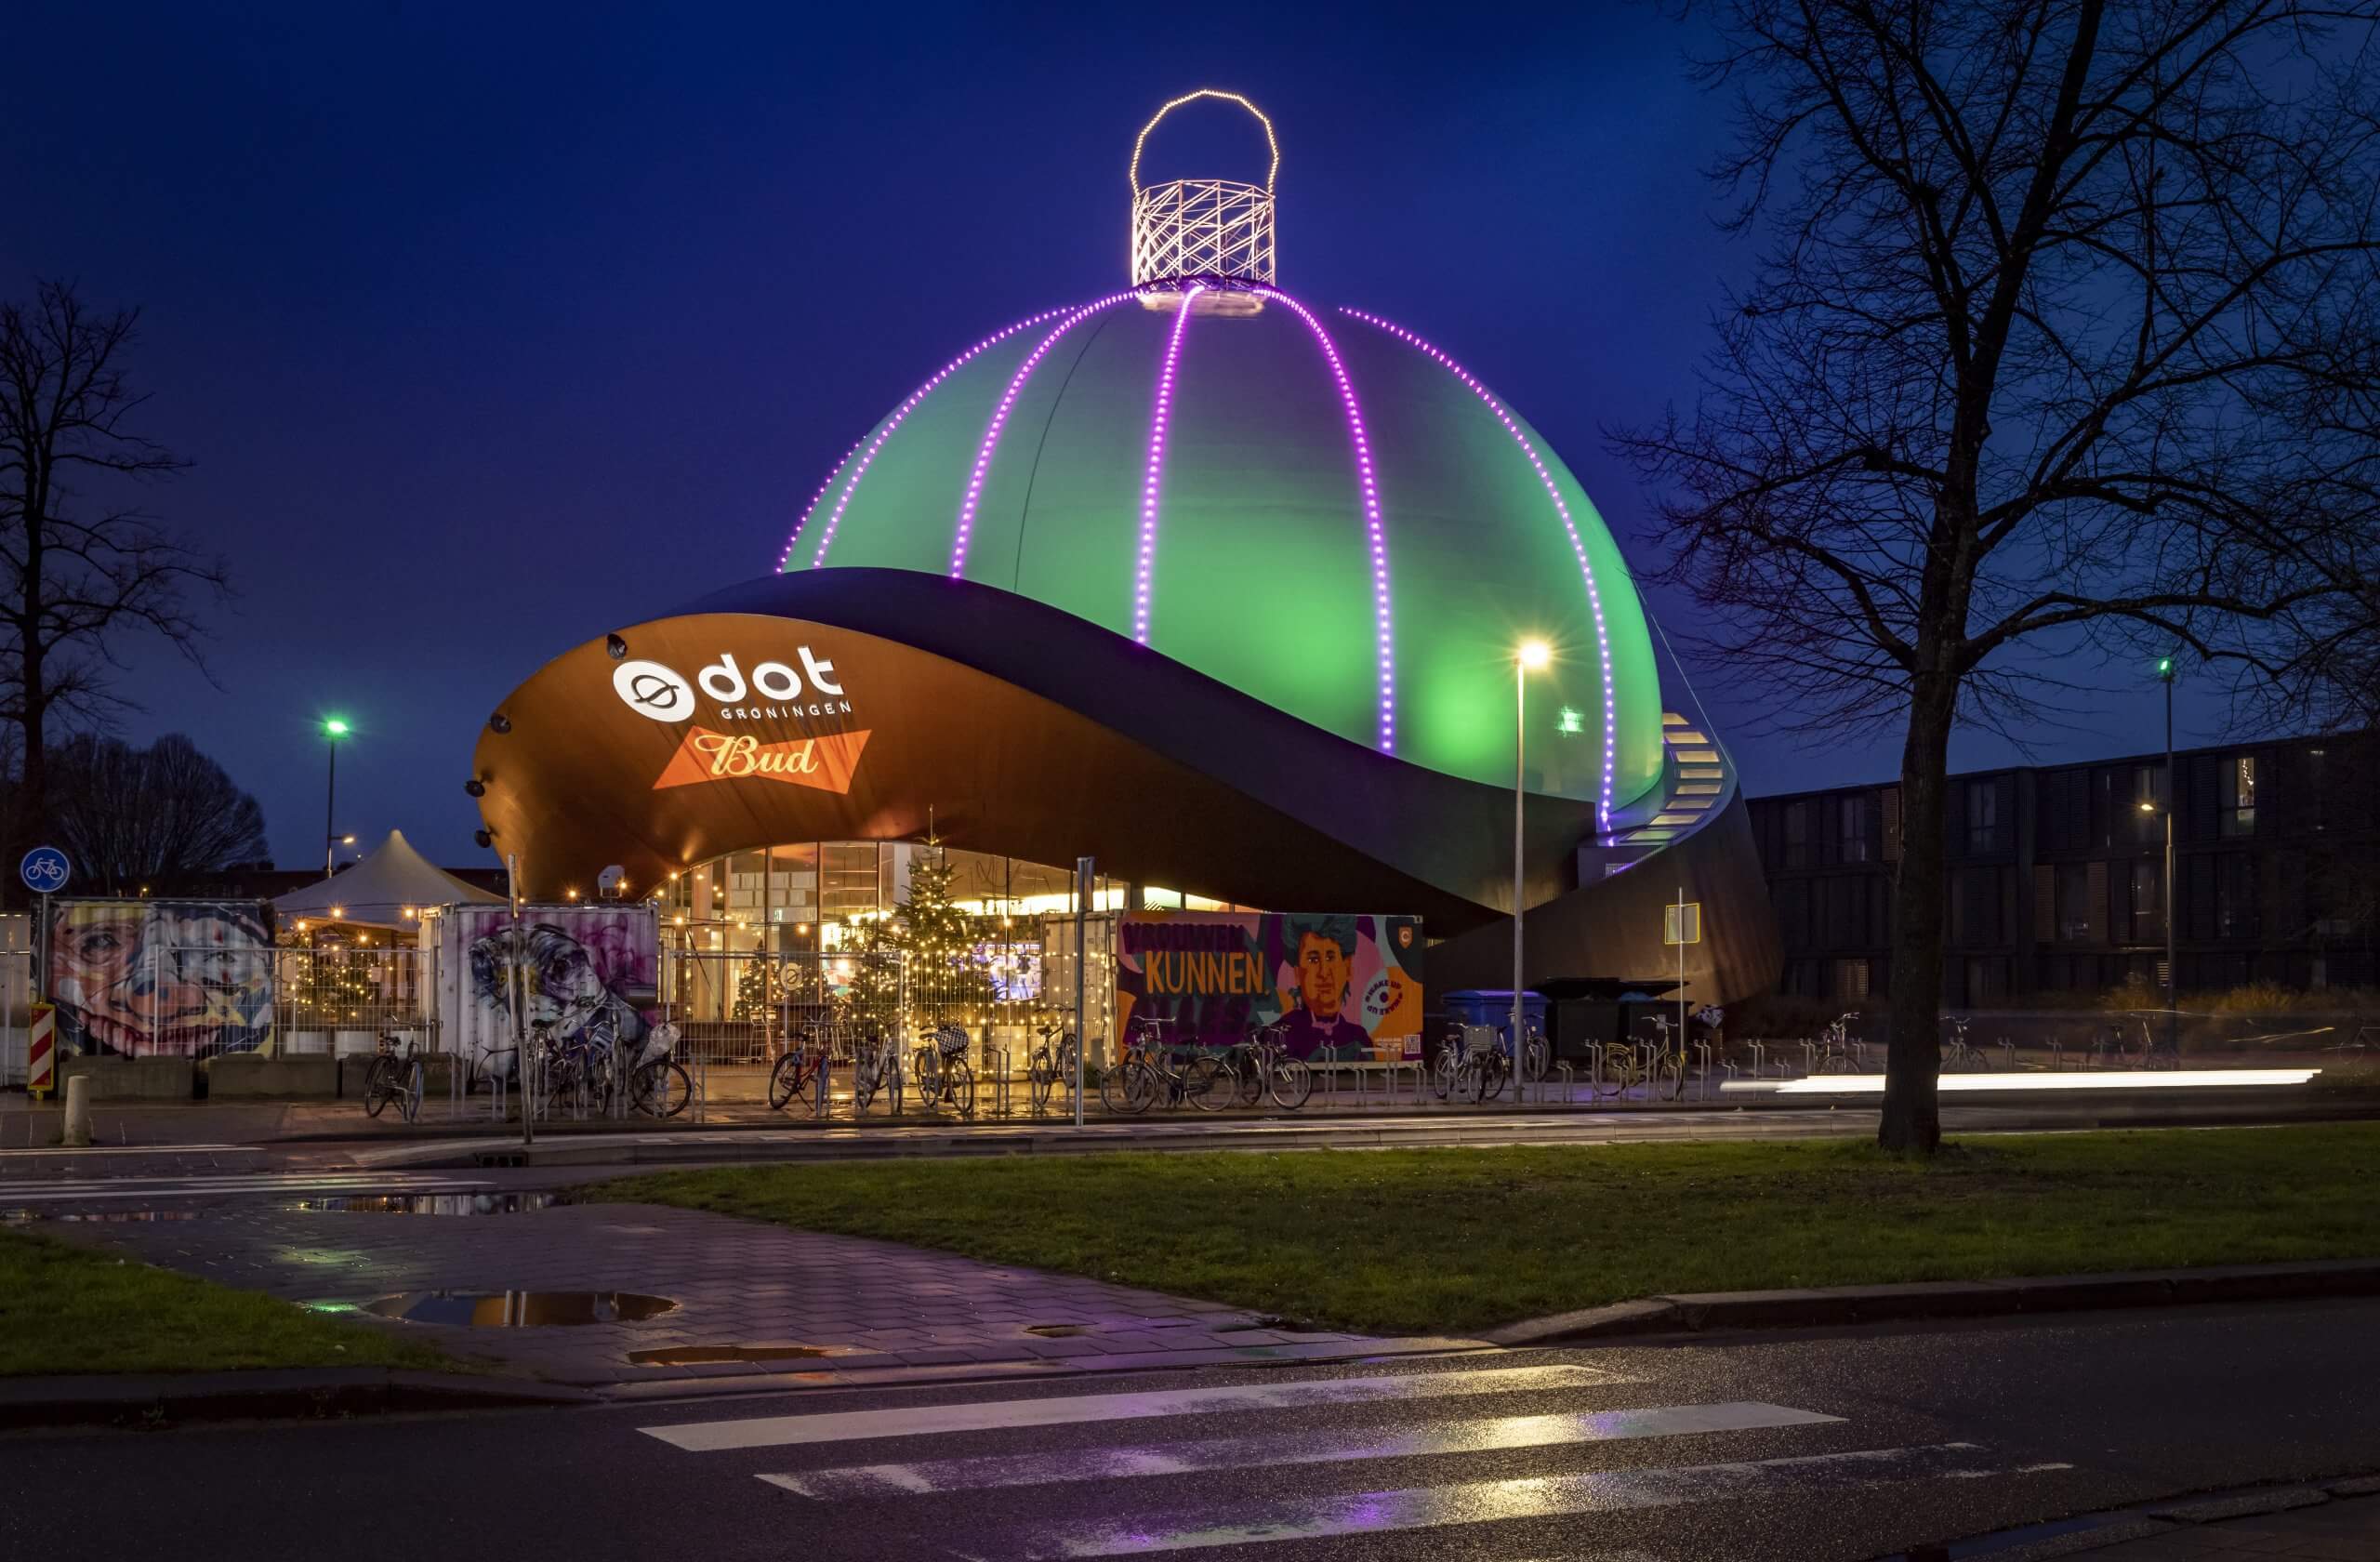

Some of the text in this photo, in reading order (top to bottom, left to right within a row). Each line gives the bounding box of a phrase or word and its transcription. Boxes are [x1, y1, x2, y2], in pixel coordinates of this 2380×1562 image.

[698, 644, 845, 703] dot
[721, 700, 853, 721] GRONINGEN
[694, 735, 818, 777] Bud
[1144, 950, 1271, 997] KUNNEN.
[1368, 979, 1402, 996] WAKE UP
